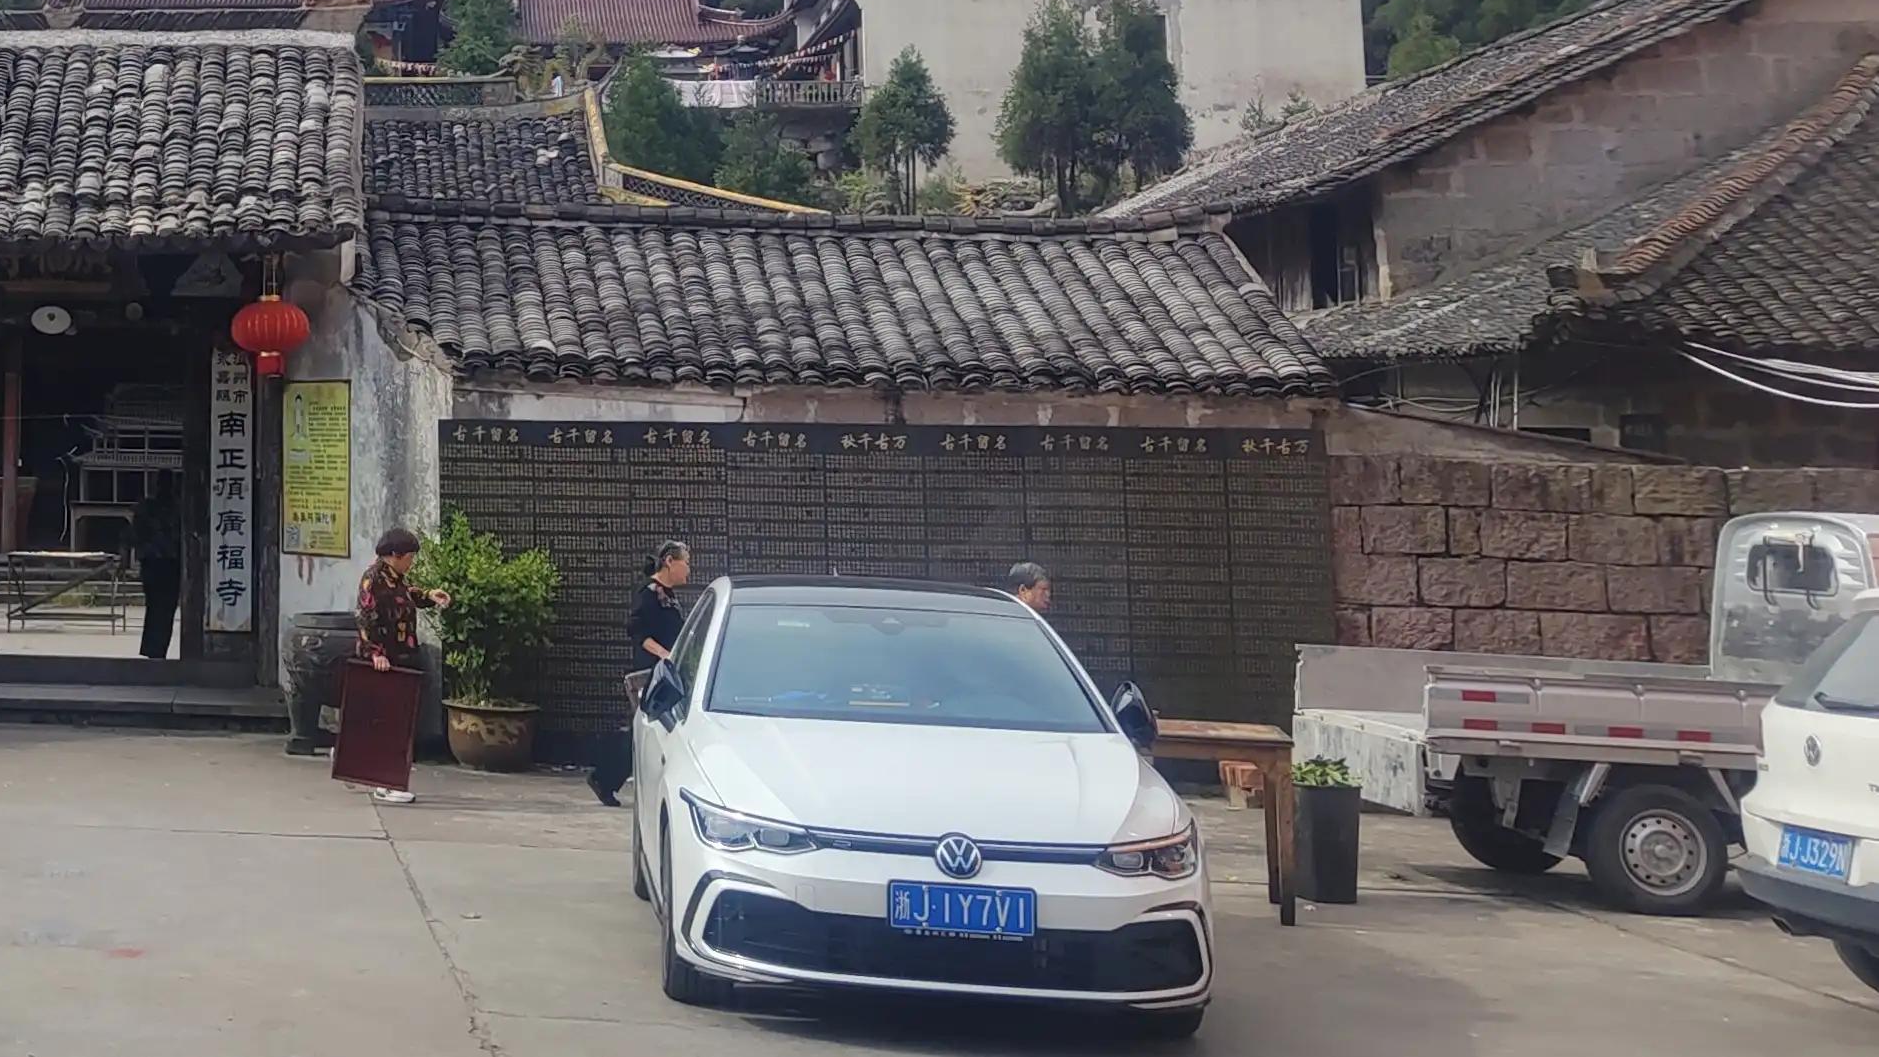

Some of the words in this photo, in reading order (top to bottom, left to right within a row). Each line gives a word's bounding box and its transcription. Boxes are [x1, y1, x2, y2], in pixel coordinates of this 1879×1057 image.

[215, 411, 248, 607] 南正頂廣福寺
